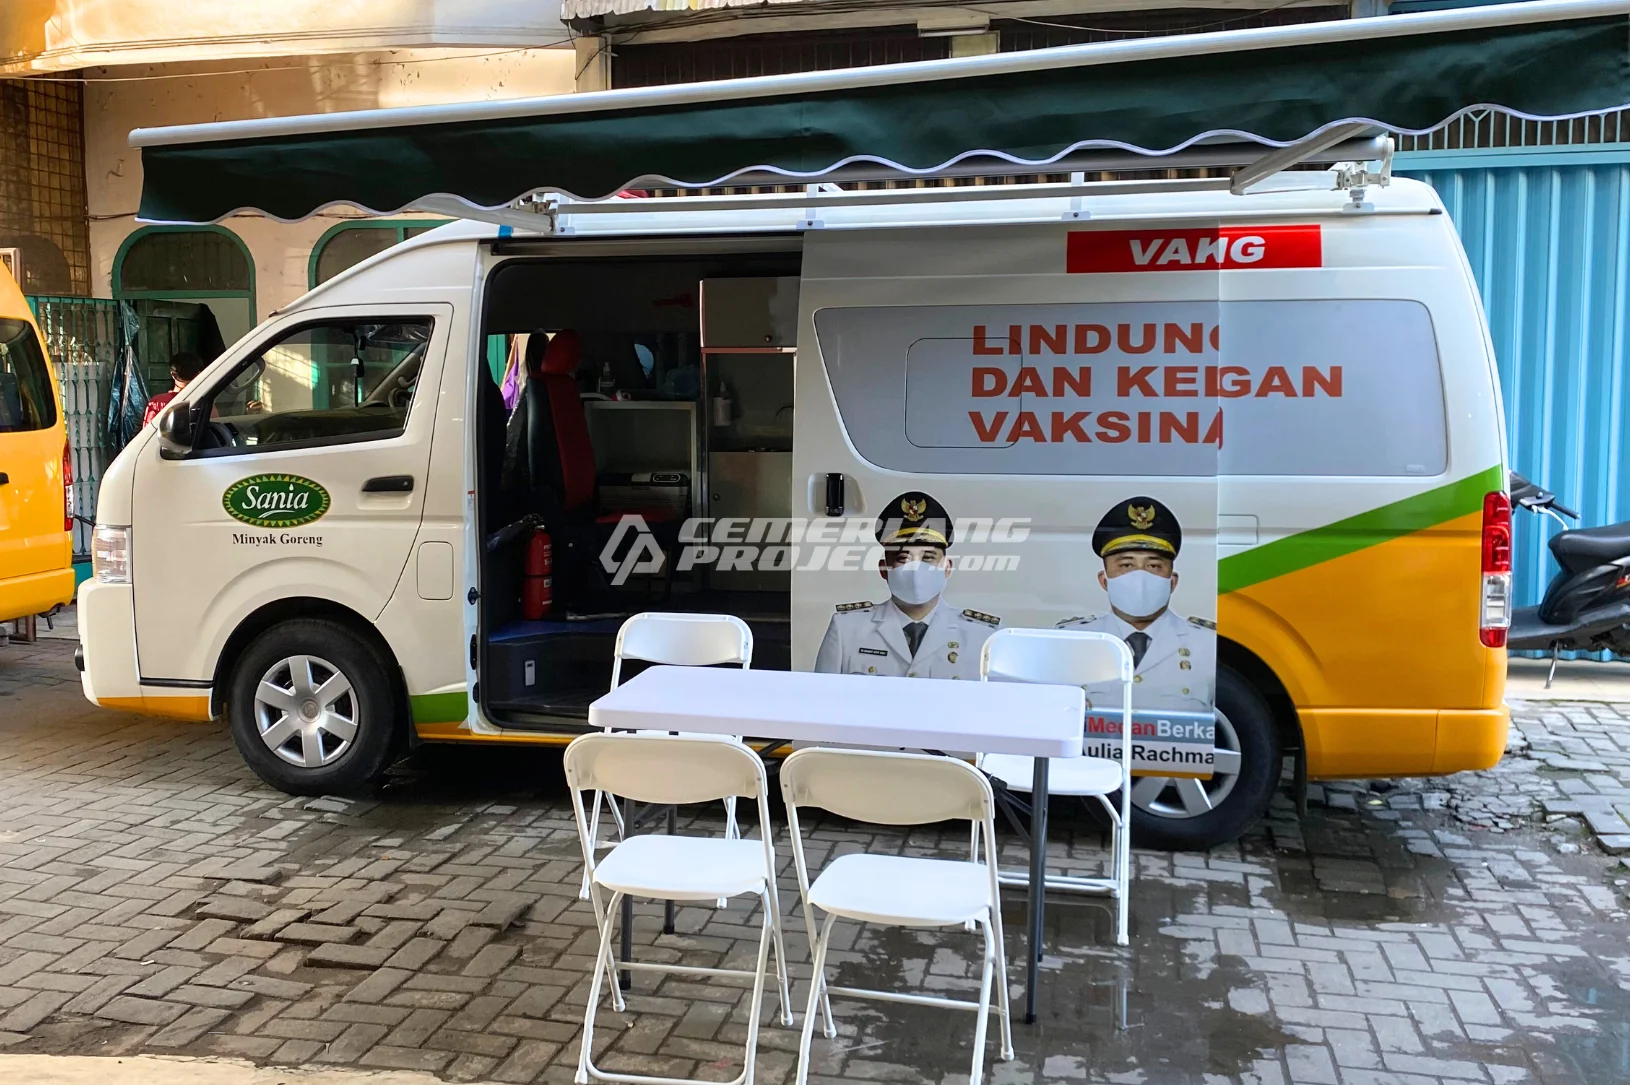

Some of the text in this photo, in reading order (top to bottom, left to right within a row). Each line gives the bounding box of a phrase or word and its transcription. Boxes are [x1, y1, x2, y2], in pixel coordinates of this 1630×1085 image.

[971, 366, 1092, 398] DAN
[241, 483, 310, 510] Sania
[232, 533, 323, 547] Minyak Goreng
[1082, 743, 1215, 765] ulia Rachma
